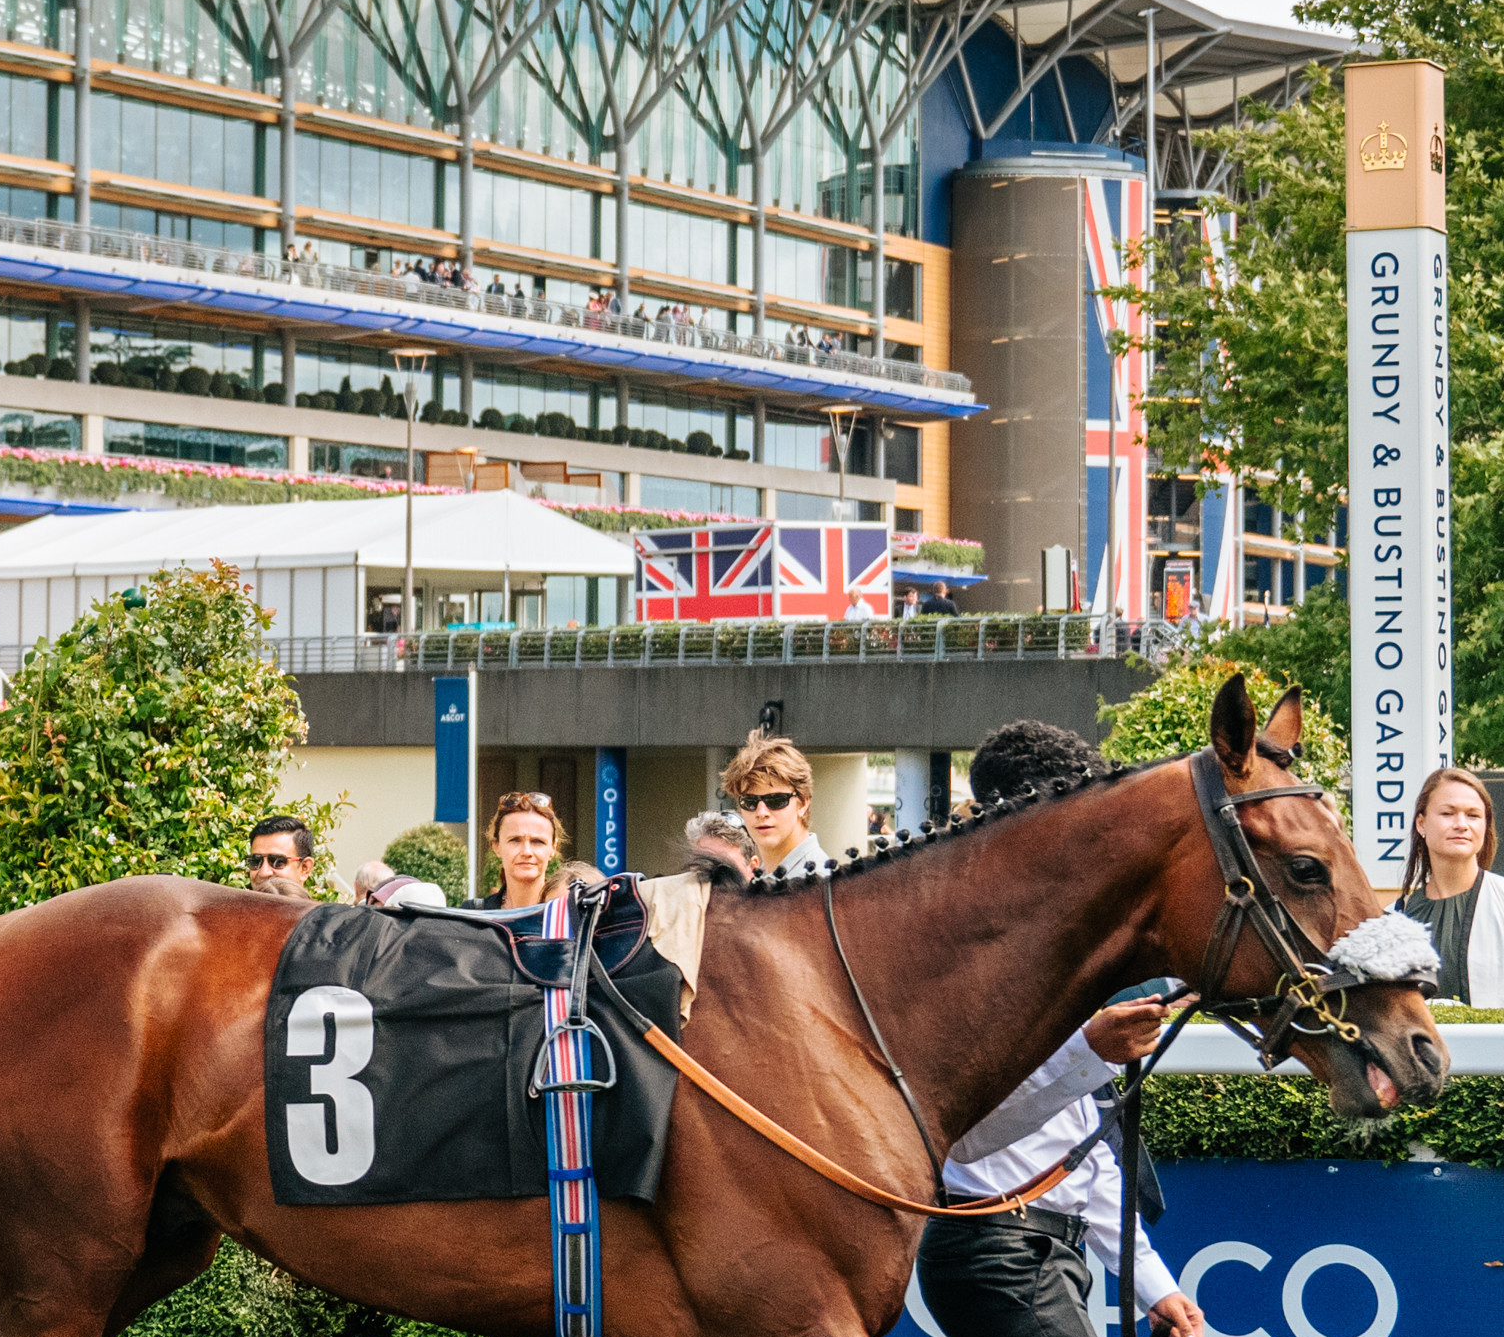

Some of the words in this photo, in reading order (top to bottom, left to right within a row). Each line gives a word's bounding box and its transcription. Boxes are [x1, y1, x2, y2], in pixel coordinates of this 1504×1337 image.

[1371, 251, 1400, 425] GRUNDY
[1433, 253, 1444, 427] GRUNDY
[1372, 443, 1401, 469] &
[1436, 443, 1445, 468] &
[1373, 487, 1404, 670] BUSTINO
[1436, 488, 1447, 671] BUSTINO
[440, 713, 466, 722] ASCOT
[1375, 689, 1405, 861] GARDEN
[603, 788, 618, 868] QIPCO
[286, 985, 375, 1186] 3
